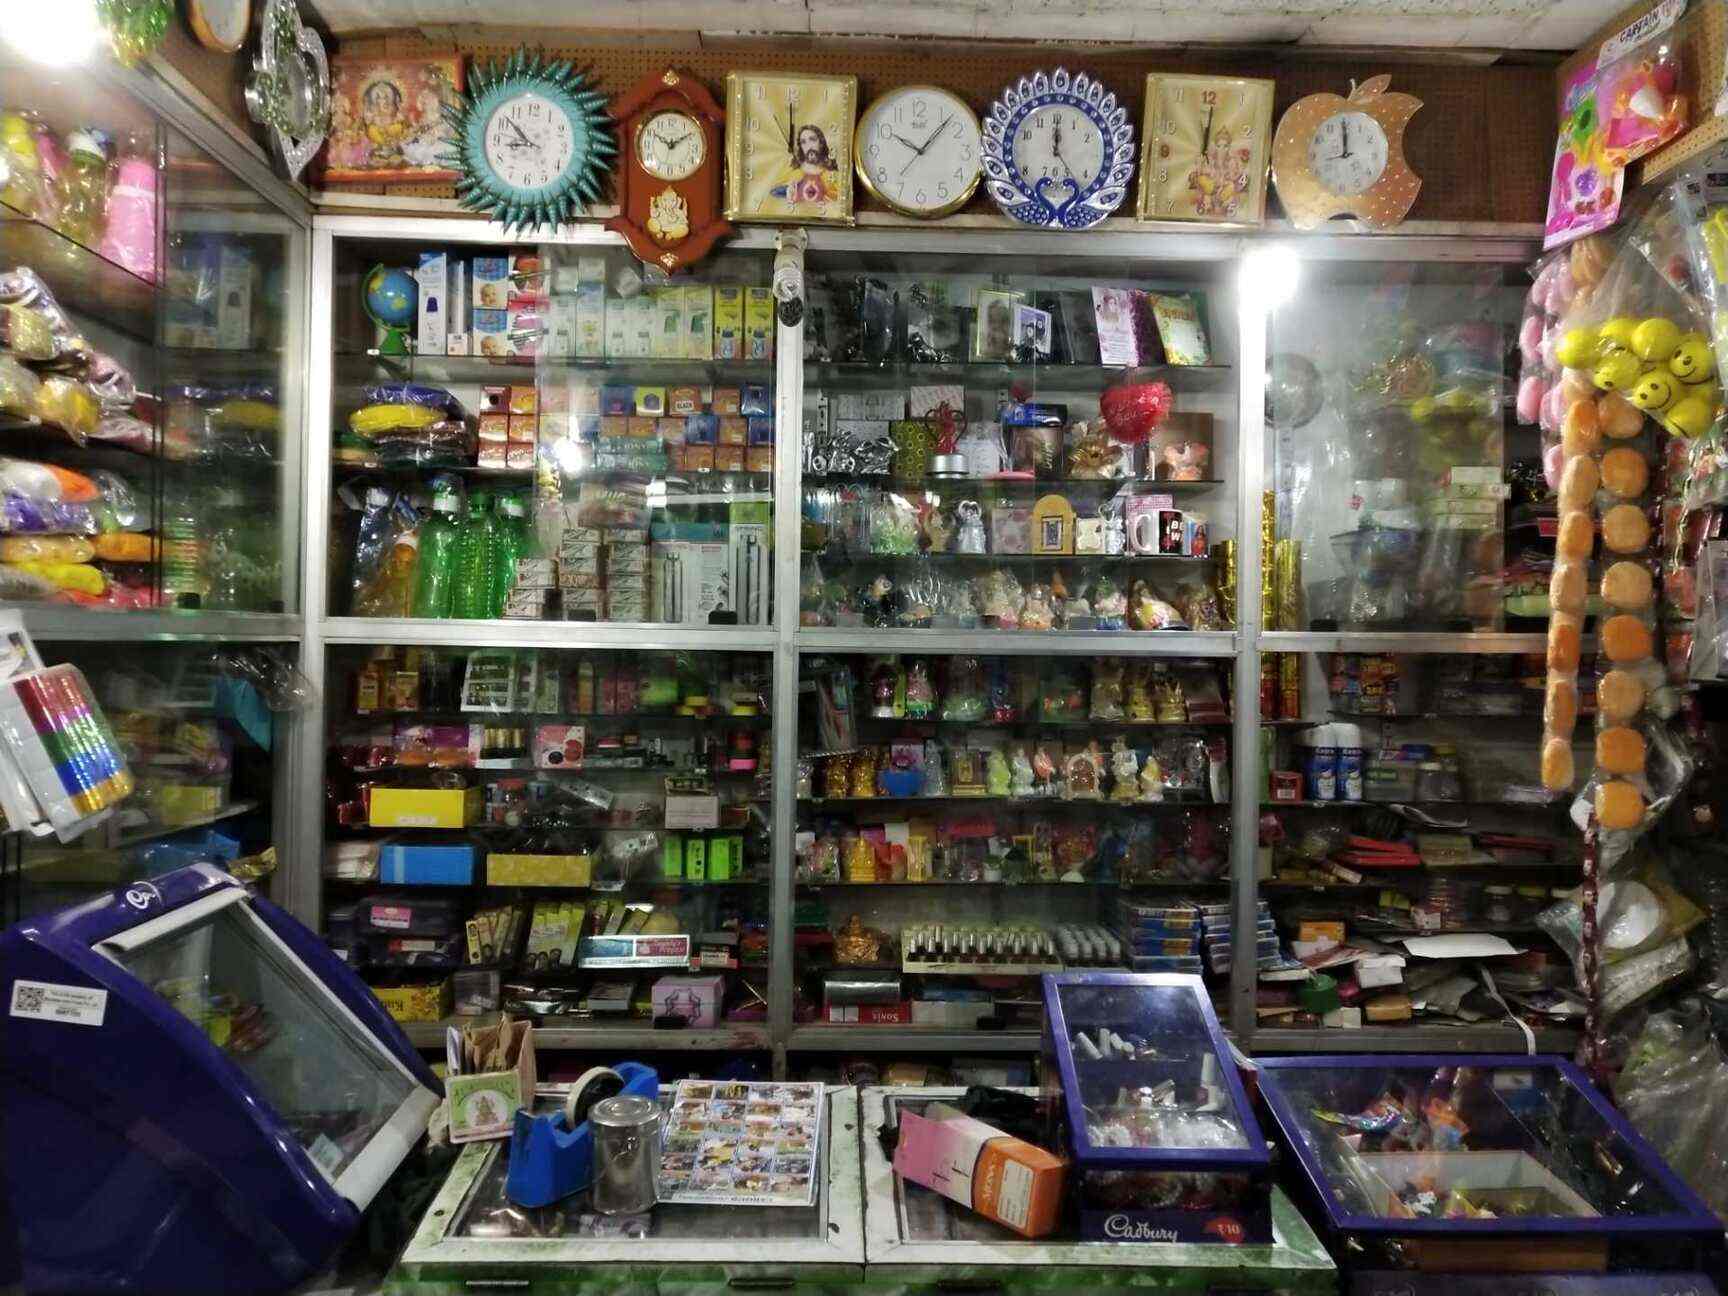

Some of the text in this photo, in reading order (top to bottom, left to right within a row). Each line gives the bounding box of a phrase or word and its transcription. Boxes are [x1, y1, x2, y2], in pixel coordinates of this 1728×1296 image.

[785, 85, 799, 103] 12
[1202, 91, 1216, 105] 12
[528, 103, 540, 118] 12
[893, 106, 903, 123] 11
[912, 99, 927, 119] 12
[876, 122, 893, 140] 10
[952, 121, 965, 139] 2
[1023, 130, 1032, 141] 10
[868, 144, 880, 160] 9
[960, 144, 972, 161] 3
[1160, 144, 1170, 158] 9
[877, 166, 888, 183] 8
[953, 167, 964, 182] 4
[1159, 169, 1168, 183] 8
[896, 182, 905, 199] 7
[915, 188, 927, 204] 6
[937, 182, 949, 199] 5
[1104, 1214, 1178, 1243] Cadbury
